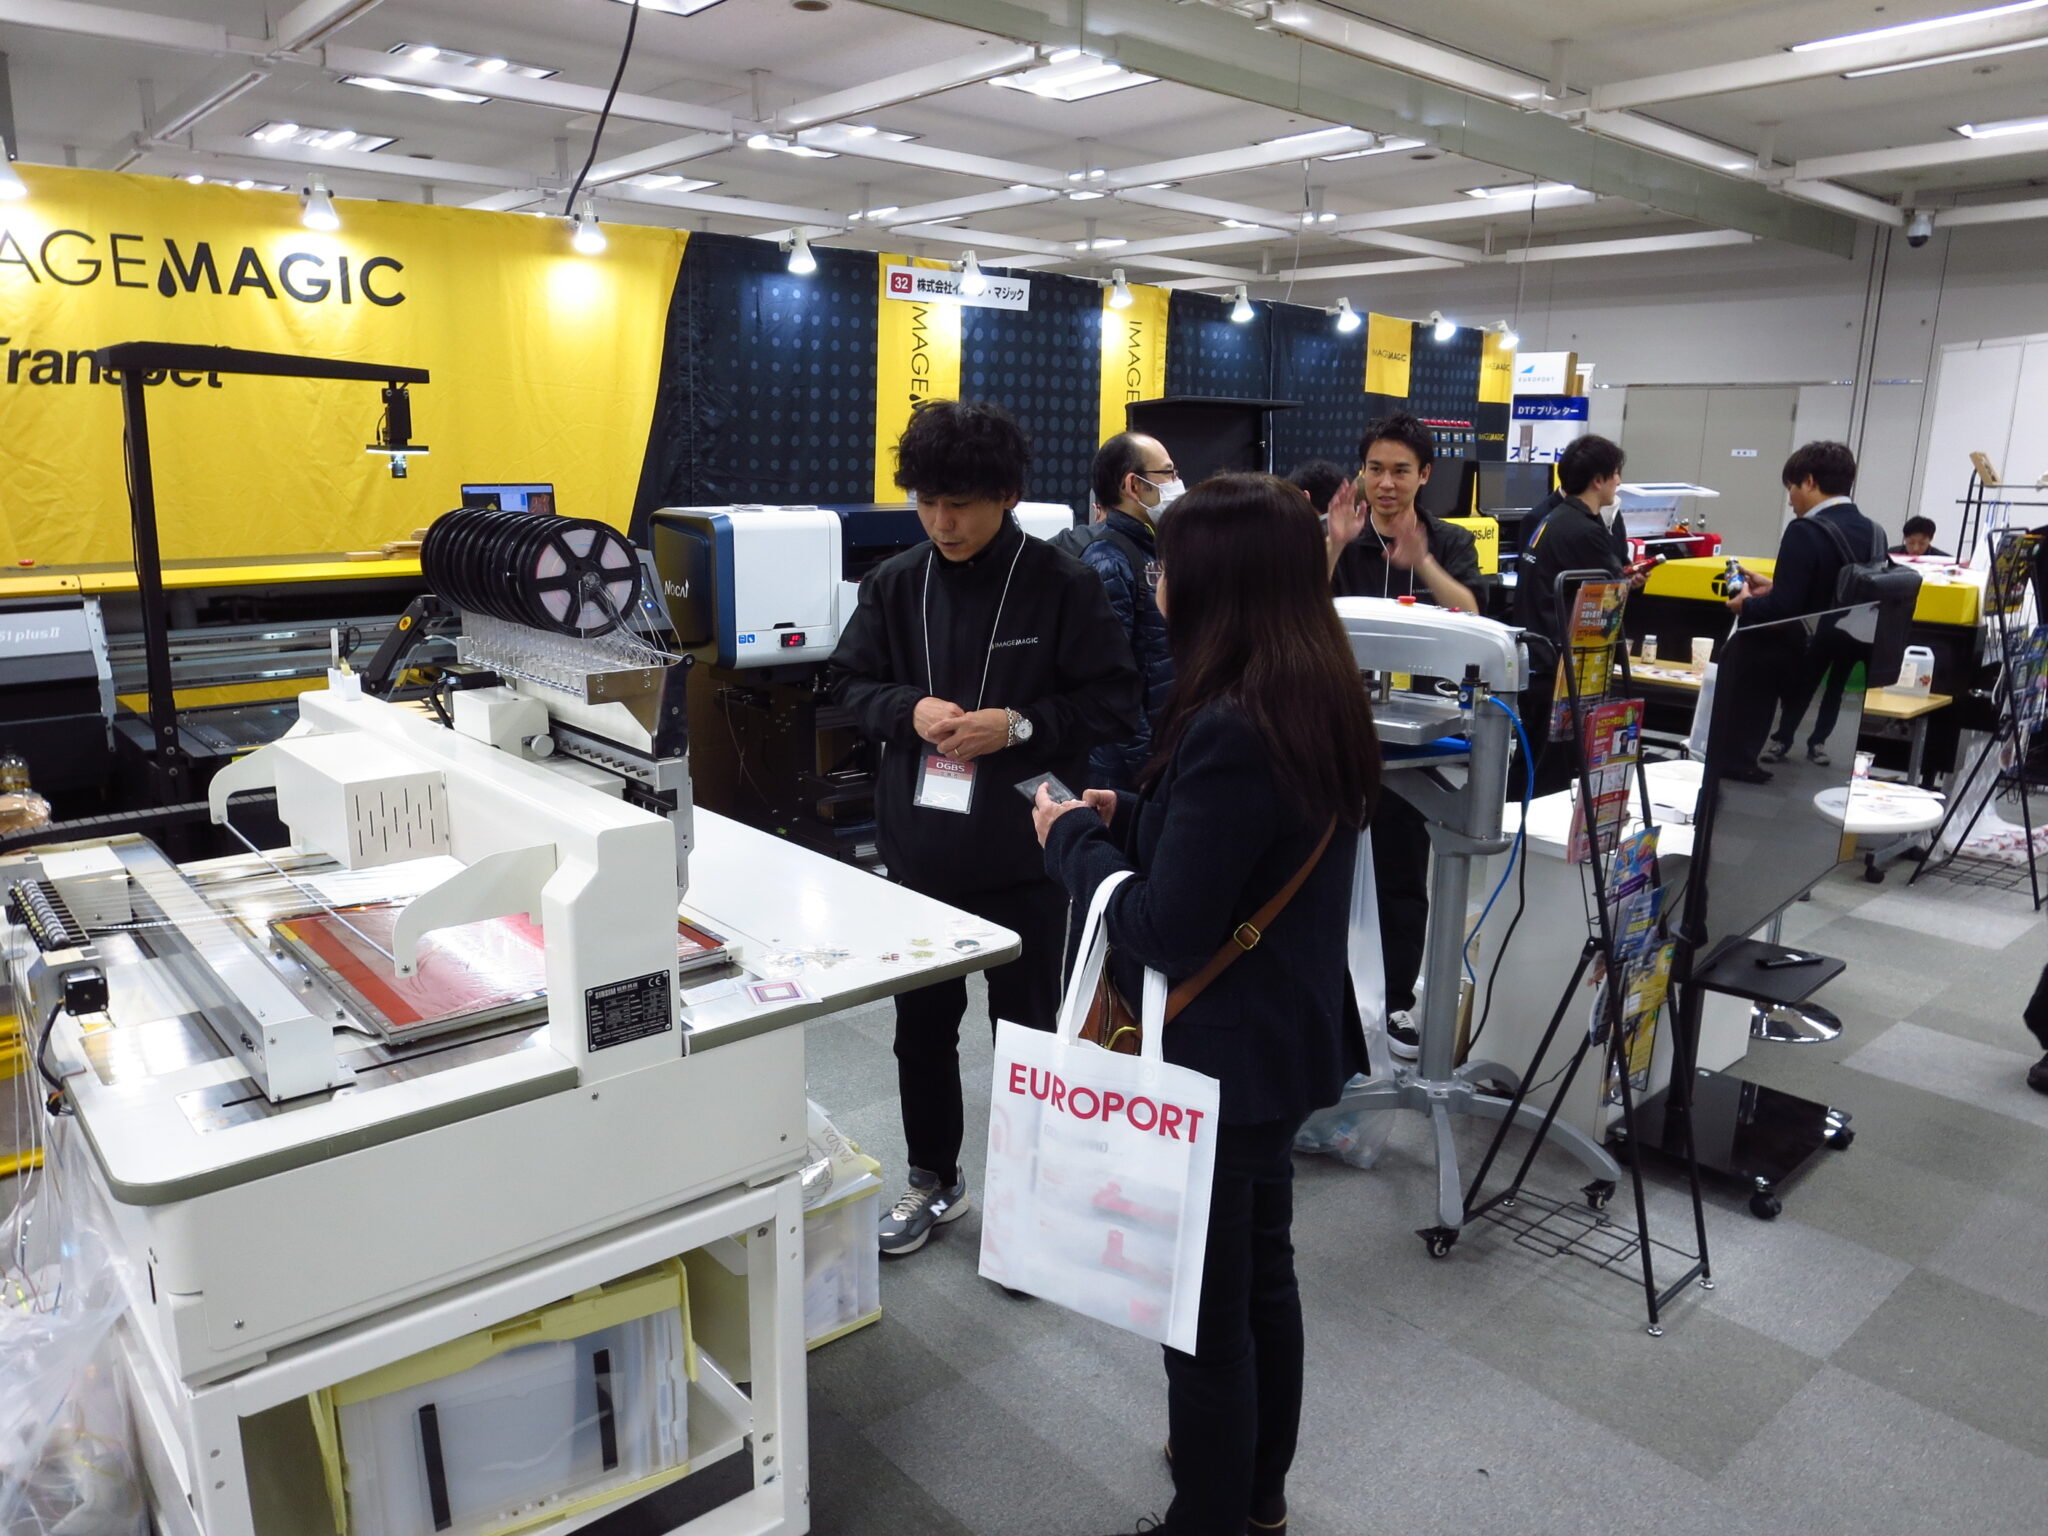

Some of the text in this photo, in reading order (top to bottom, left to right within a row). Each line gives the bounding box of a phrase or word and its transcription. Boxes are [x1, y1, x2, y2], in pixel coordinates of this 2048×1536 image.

[894, 276, 909, 290] 32
[916, 277, 1025, 302] 株式会社イ・マジック
[936, 761, 965, 772] OGBS
[1008, 1062, 1204, 1144] EUROPORT
